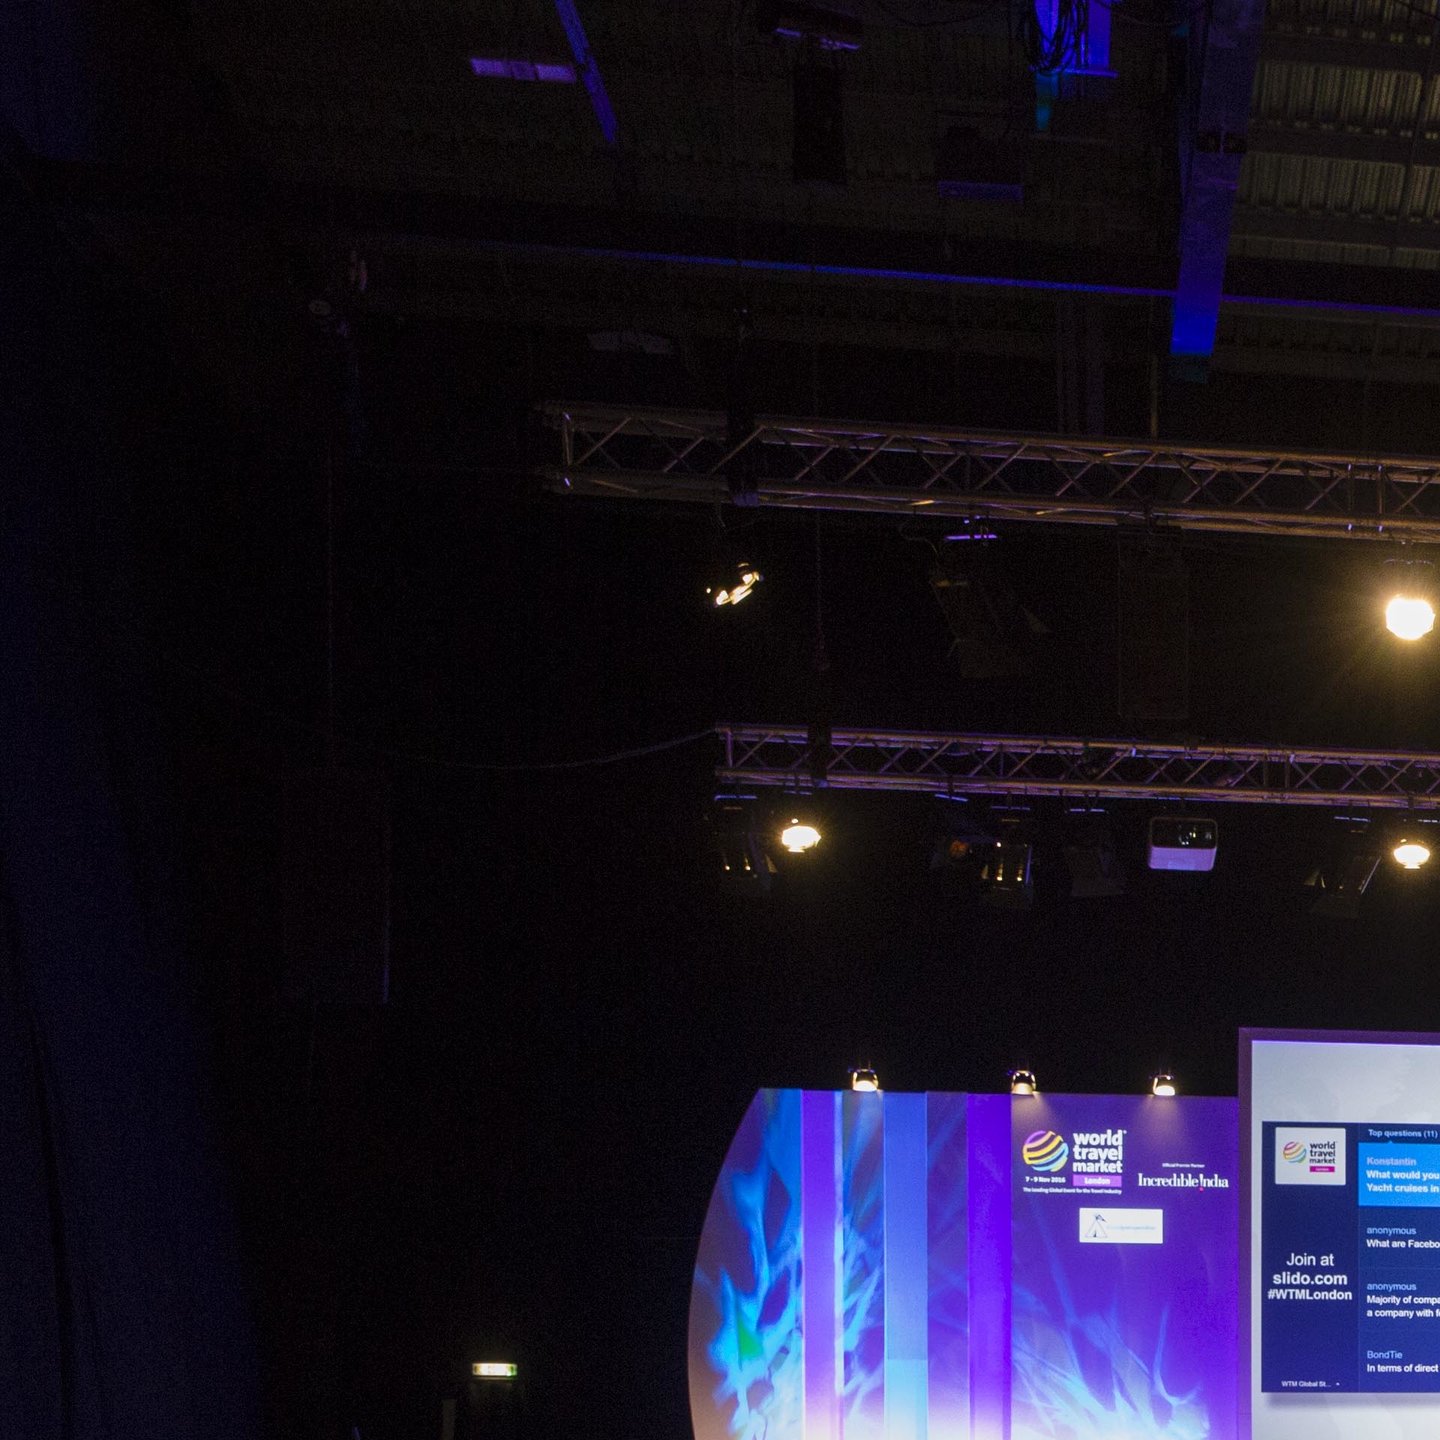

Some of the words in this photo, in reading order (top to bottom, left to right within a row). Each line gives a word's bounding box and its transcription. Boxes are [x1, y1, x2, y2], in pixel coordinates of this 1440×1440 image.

[1073, 1130, 1122, 1145] world
[1368, 1129, 1382, 1138] Top
[1384, 1130, 1422, 1139] questions
[1423, 1130, 1438, 1139] (11)
[1310, 1141, 1336, 1150] world
[1073, 1146, 1122, 1160] travel
[1310, 1149, 1336, 1158] travel
[1310, 1157, 1336, 1165] market
[1367, 1157, 1416, 1167] Konstantin
[1073, 1160, 1122, 1173] market
[1138, 1173, 1199, 1187] Incredible
[1367, 1171, 1391, 1180] What
[1392, 1171, 1421, 1180] would
[1422, 1173, 1440, 1182] you
[1367, 1183, 1392, 1193] Yacht
[1394, 1184, 1428, 1194] cruises
[1430, 1184, 1440, 1194] in
[1367, 1227, 1417, 1237] anonymous
[1367, 1239, 1391, 1249] What
[1392, 1241, 1406, 1249] are
[1287, 1252, 1316, 1267] Join
[1320, 1254, 1335, 1267] at
[1273, 1272, 1348, 1285] slido.com
[1367, 1283, 1417, 1293] anonymous
[1268, 1289, 1353, 1301] #WTMLondon
[1367, 1295, 1401, 1306] Majority
[1403, 1295, 1412, 1304] of
[1367, 1310, 1373, 1318] a
[1375, 1310, 1414, 1320] company
[1416, 1309, 1434, 1318] with
[1367, 1350, 1403, 1360] BondTie
[1367, 1364, 1376, 1373] In
[1378, 1364, 1402, 1373] terms
[1404, 1363, 1413, 1373] of
[1415, 1363, 1438, 1373] direct
[1282, 1379, 1298, 1388] WTM
